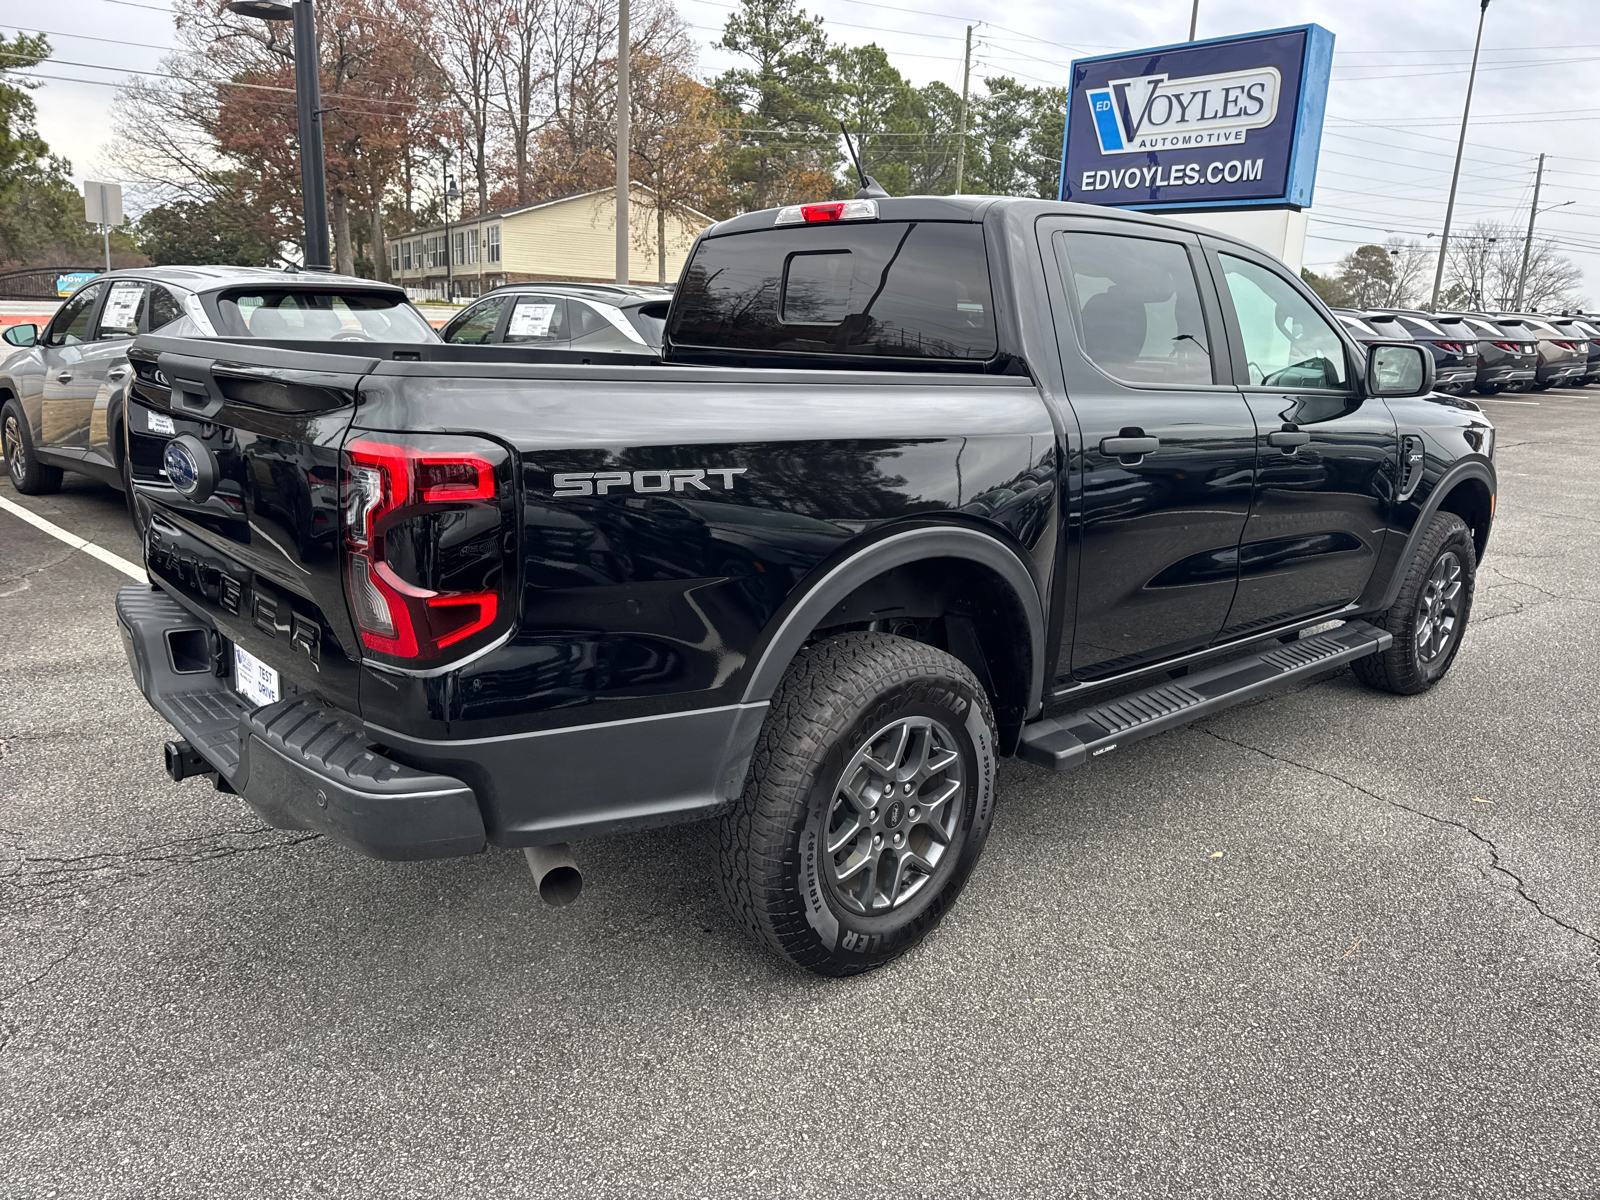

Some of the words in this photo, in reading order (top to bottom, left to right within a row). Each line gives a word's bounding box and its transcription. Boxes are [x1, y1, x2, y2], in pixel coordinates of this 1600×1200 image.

[1096, 101, 1111, 112] ED
[1113, 78, 1265, 142] VOYLES
[1139, 130, 1243, 148] AUTOMOTIVE
[1081, 158, 1263, 191] EDVOYLES.COM
[60, 275, 83, 283] Now
[1410, 454, 1423, 462] XLT
[553, 468, 747, 496] SPORT
[148, 527, 321, 668] RANGER
[259, 665, 272, 685] TEST
[258, 681, 276, 703] DRIVE
[807, 831, 821, 913] TERRITORY
